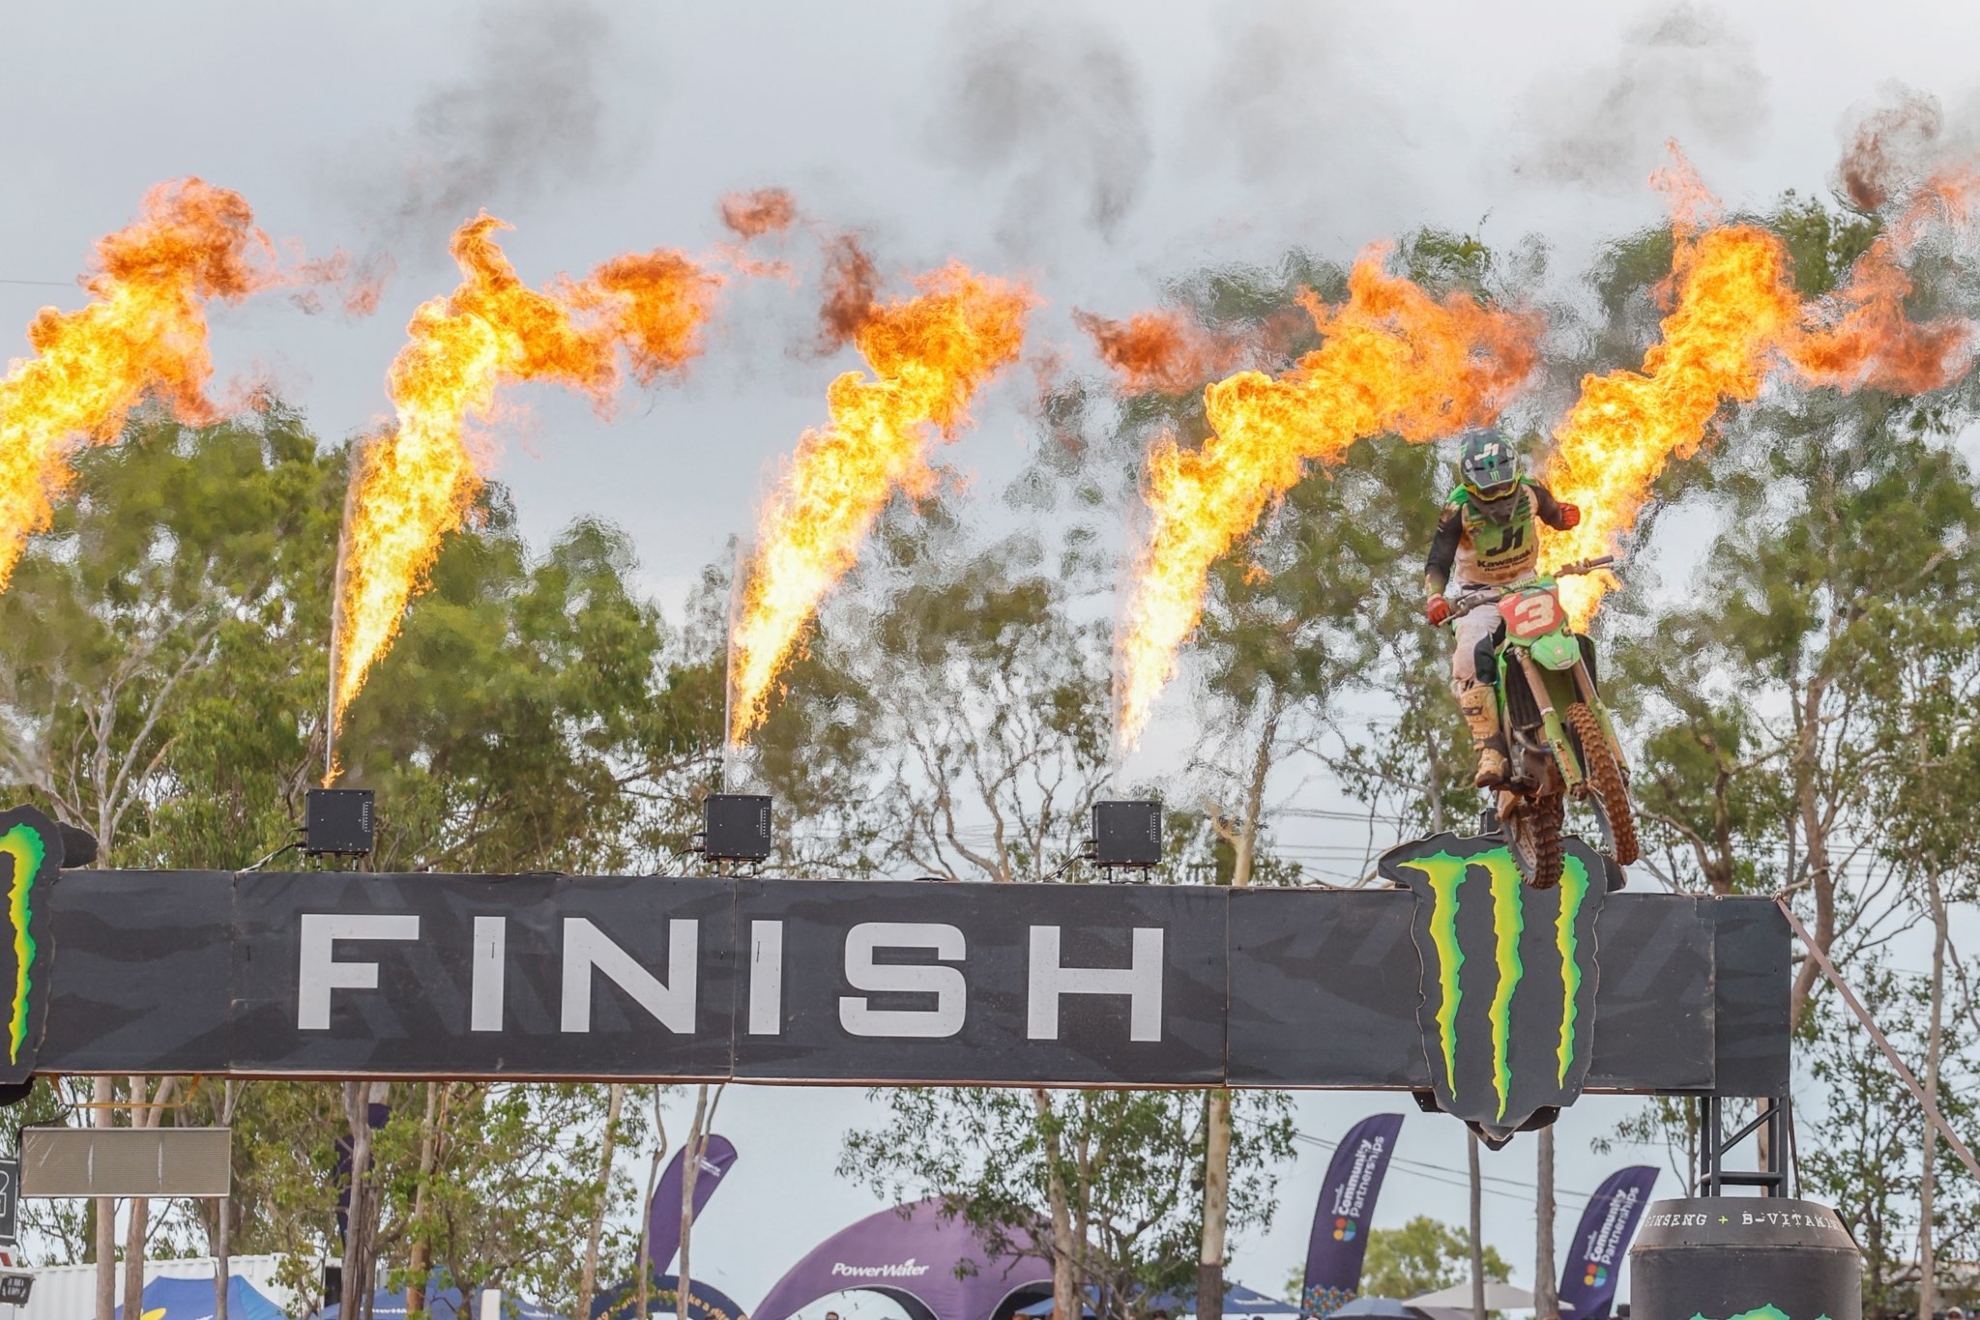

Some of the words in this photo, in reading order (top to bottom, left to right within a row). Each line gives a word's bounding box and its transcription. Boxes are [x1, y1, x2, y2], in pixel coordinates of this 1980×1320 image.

[1477, 545, 1534, 568] Kawasaki
[1514, 594, 1555, 635] 3
[296, 913, 1165, 1042] FINISH
[1338, 1139, 1372, 1216] Community
[1349, 1136, 1385, 1218] Partnerships
[1589, 1188, 1627, 1263] Community
[1601, 1186, 1640, 1265] Partnerships
